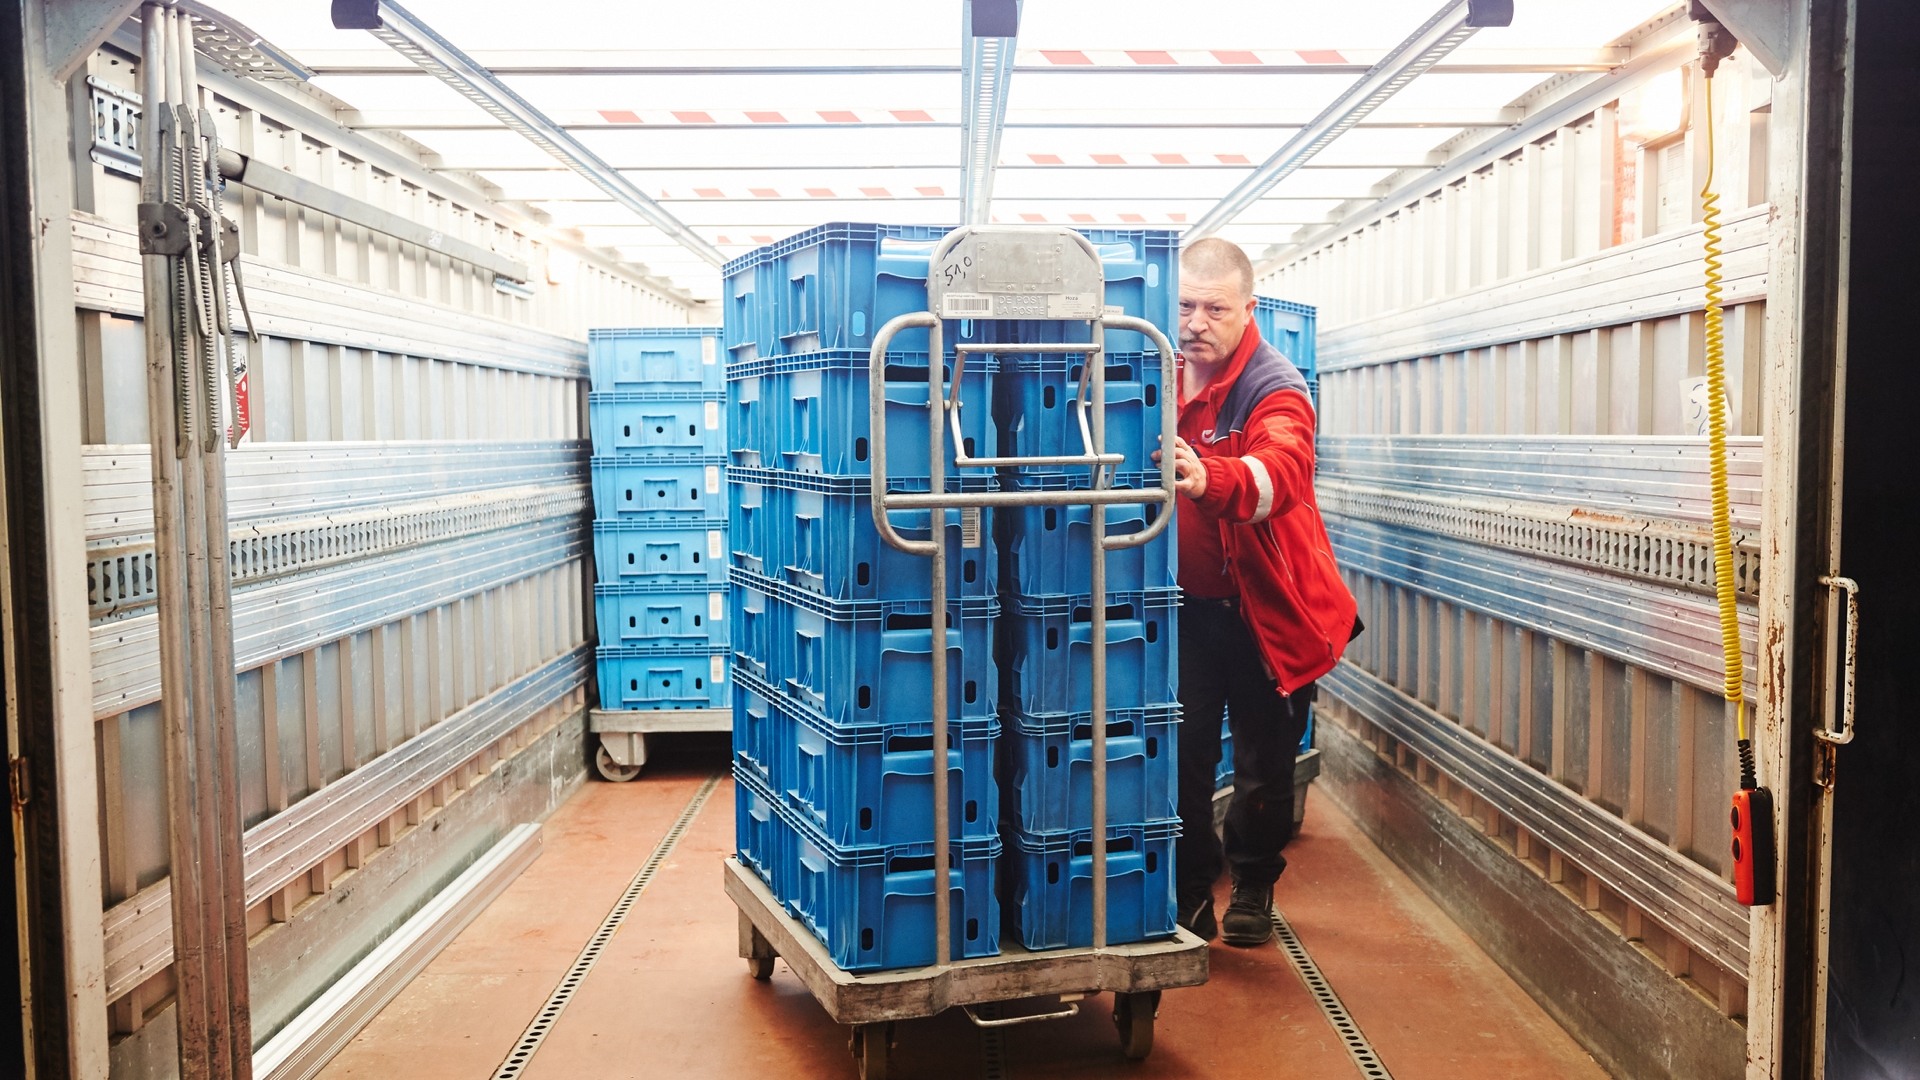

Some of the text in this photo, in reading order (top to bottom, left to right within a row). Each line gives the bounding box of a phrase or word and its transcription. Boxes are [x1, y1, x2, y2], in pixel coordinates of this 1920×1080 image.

[998, 295, 1043, 304] DE POST
[996, 306, 1045, 316] LA POSTE
